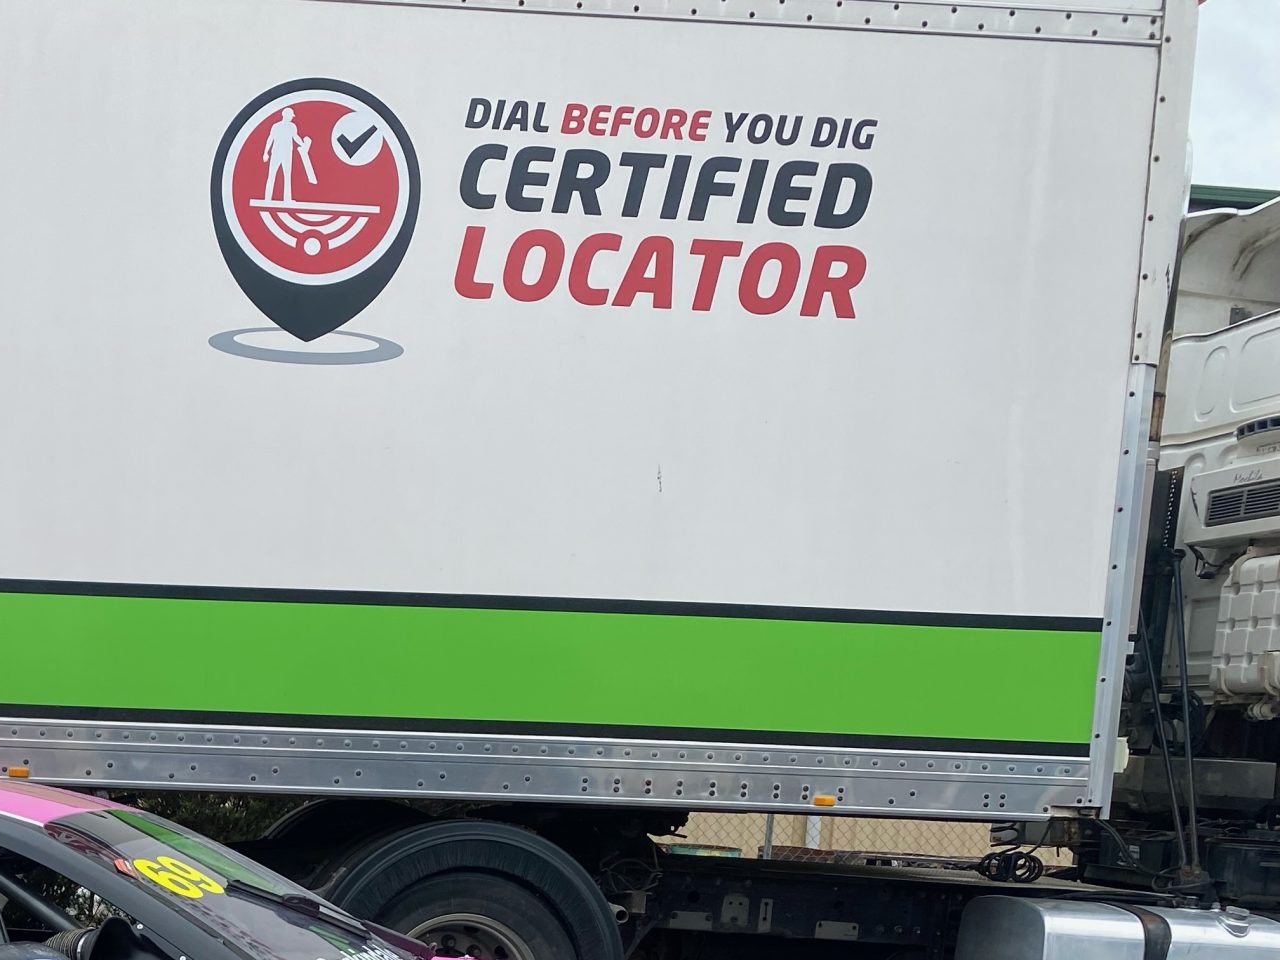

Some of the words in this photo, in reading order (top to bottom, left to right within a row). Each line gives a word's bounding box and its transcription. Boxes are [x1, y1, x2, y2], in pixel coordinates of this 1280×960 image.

[465, 97, 548, 134] DIAL
[560, 103, 712, 142] BEFORE
[723, 112, 801, 147] YOU
[810, 116, 879, 151] DIG
[459, 144, 873, 229] CERTIFIED
[453, 226, 868, 319] LOCATOR
[133, 855, 225, 899] 69
